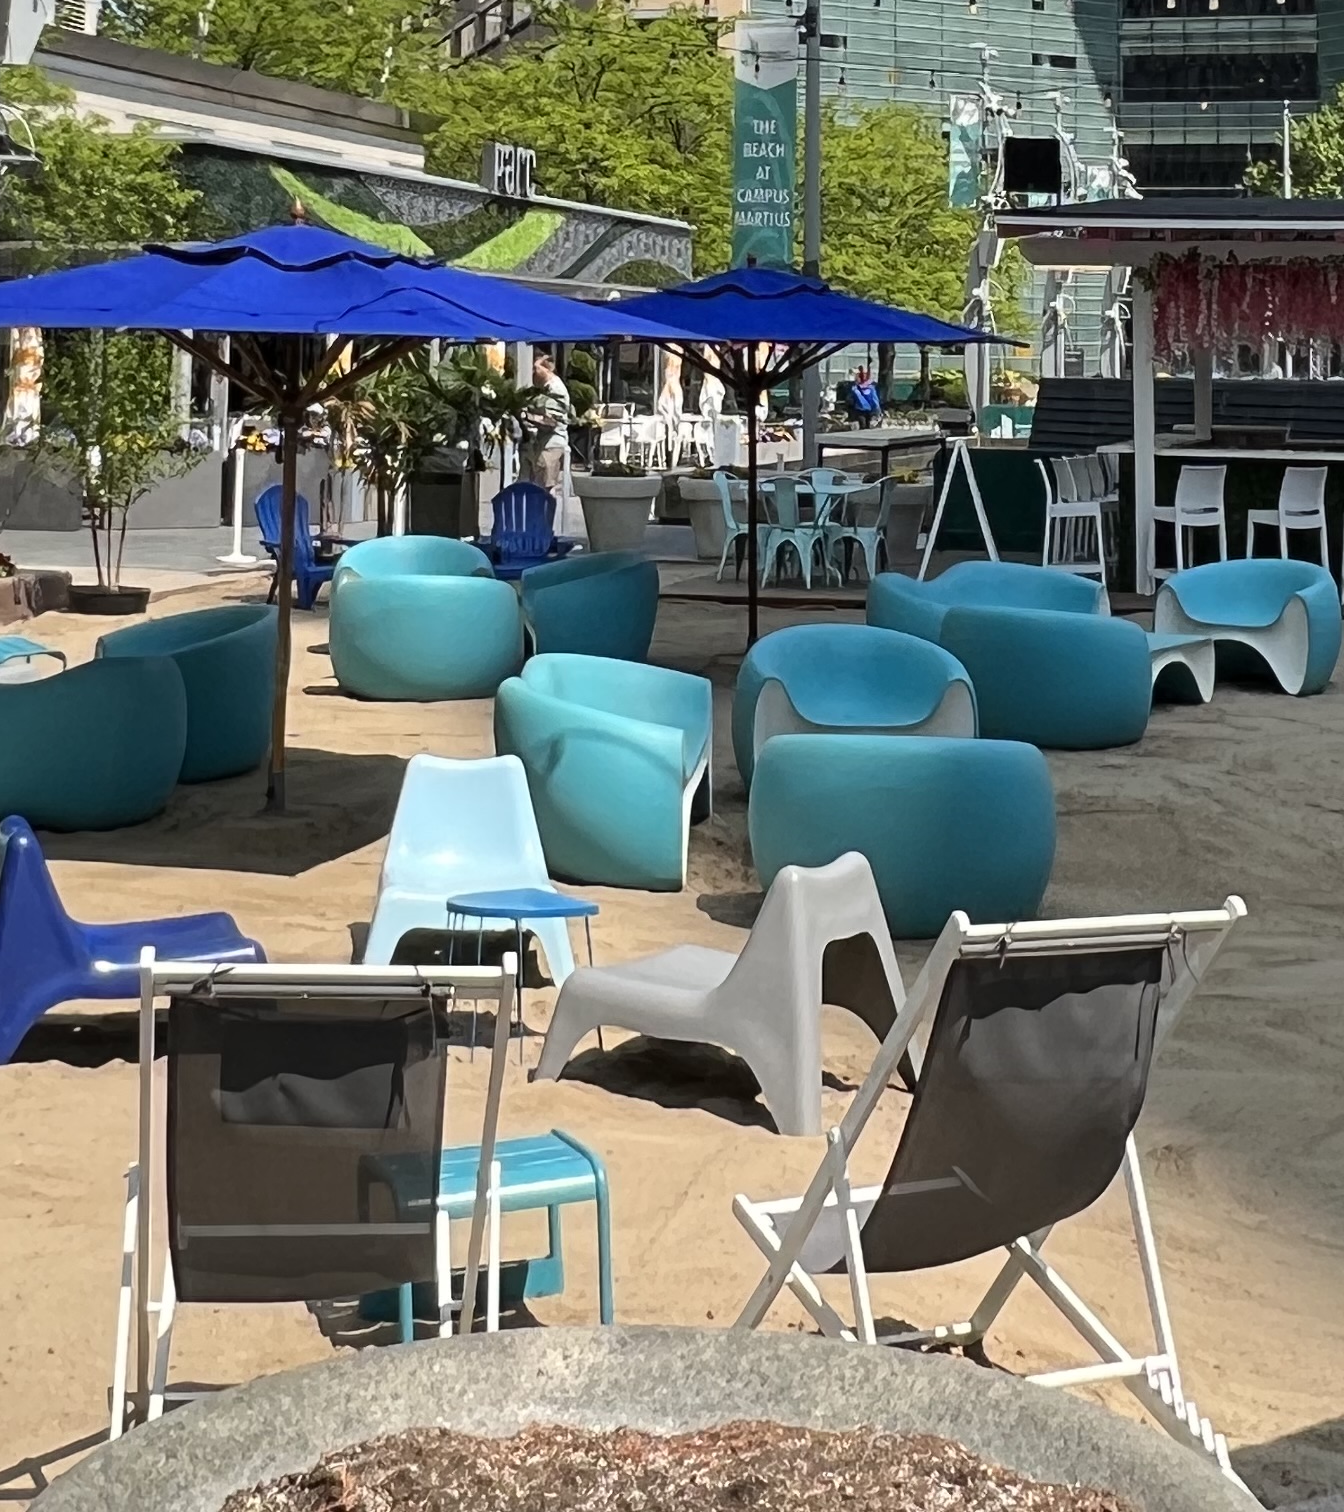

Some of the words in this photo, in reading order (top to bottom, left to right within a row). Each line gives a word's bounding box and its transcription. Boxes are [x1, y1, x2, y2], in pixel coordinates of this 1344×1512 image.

[753, 120, 777, 135] THE
[743, 142, 785, 158] BEACH
[756, 166, 771, 180] AT
[737, 188, 790, 204] CAMPUS
[735, 211, 791, 227] MARTIUS
